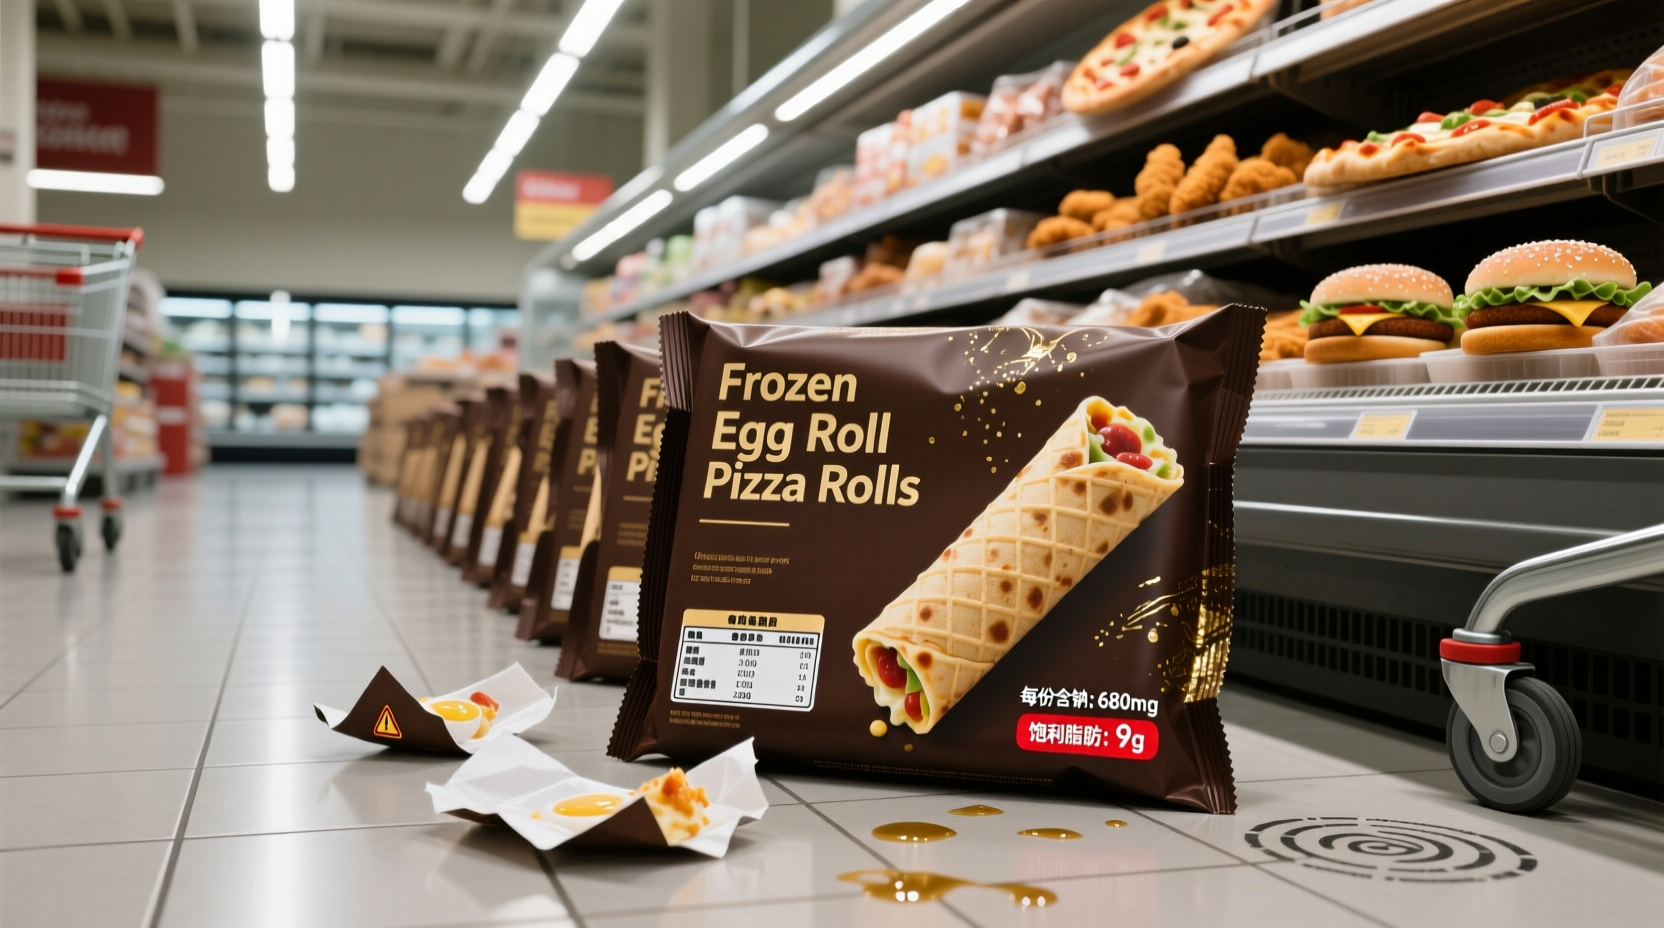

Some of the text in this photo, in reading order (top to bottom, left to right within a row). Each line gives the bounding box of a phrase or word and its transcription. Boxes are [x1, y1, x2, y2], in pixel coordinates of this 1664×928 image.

[719, 362, 858, 403] Frozen
[711, 410, 892, 462] Egg Roll
[702, 460, 921, 507] Pizza Rolls
[1097, 691, 1159, 718] 680mg
[1115, 723, 1146, 754] 9g
